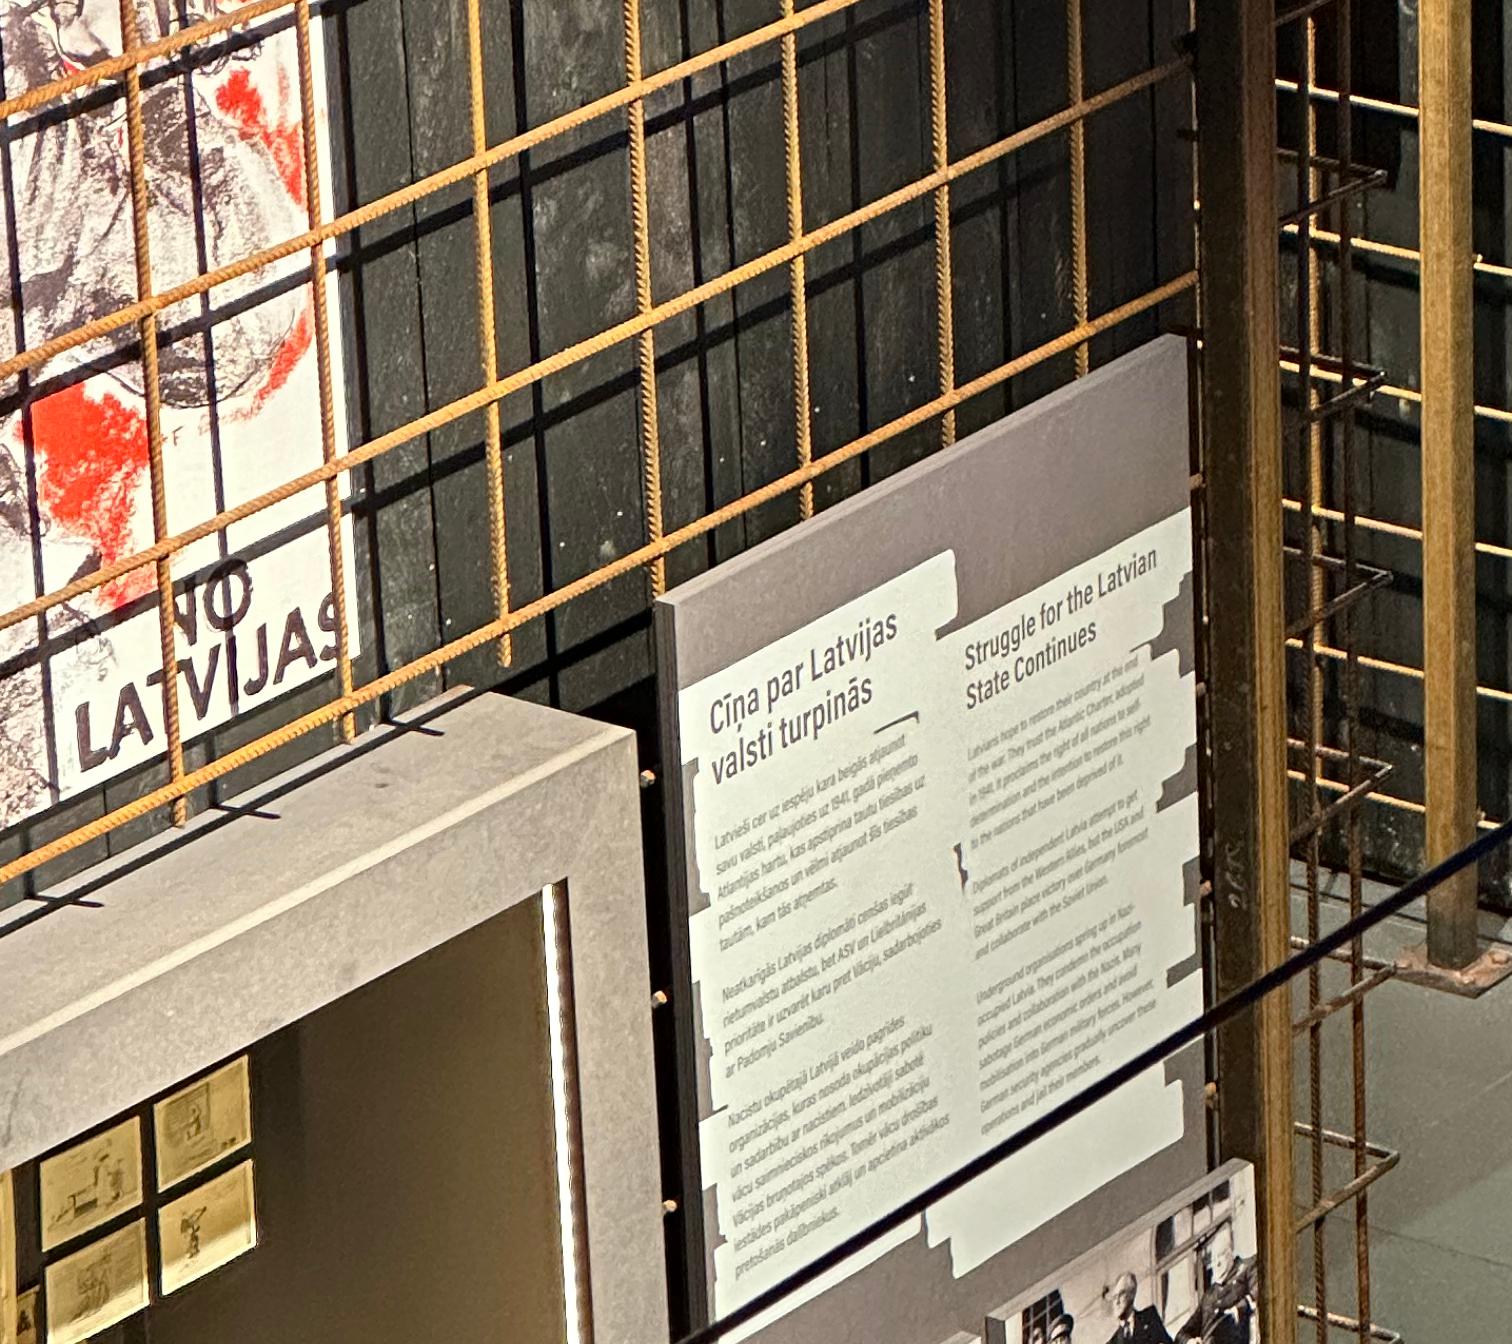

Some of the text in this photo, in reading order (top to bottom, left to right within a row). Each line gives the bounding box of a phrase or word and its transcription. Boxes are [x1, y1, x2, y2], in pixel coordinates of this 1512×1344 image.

[172, 559, 254, 646] NO
[965, 549, 1157, 671] Struggle for the Latvian
[75, 592, 341, 773] LATVIJAS
[710, 614, 897, 735] Cīņa par Latvijas
[966, 621, 1097, 710] State Continues
[711, 676, 873, 785] valsti turpinās
